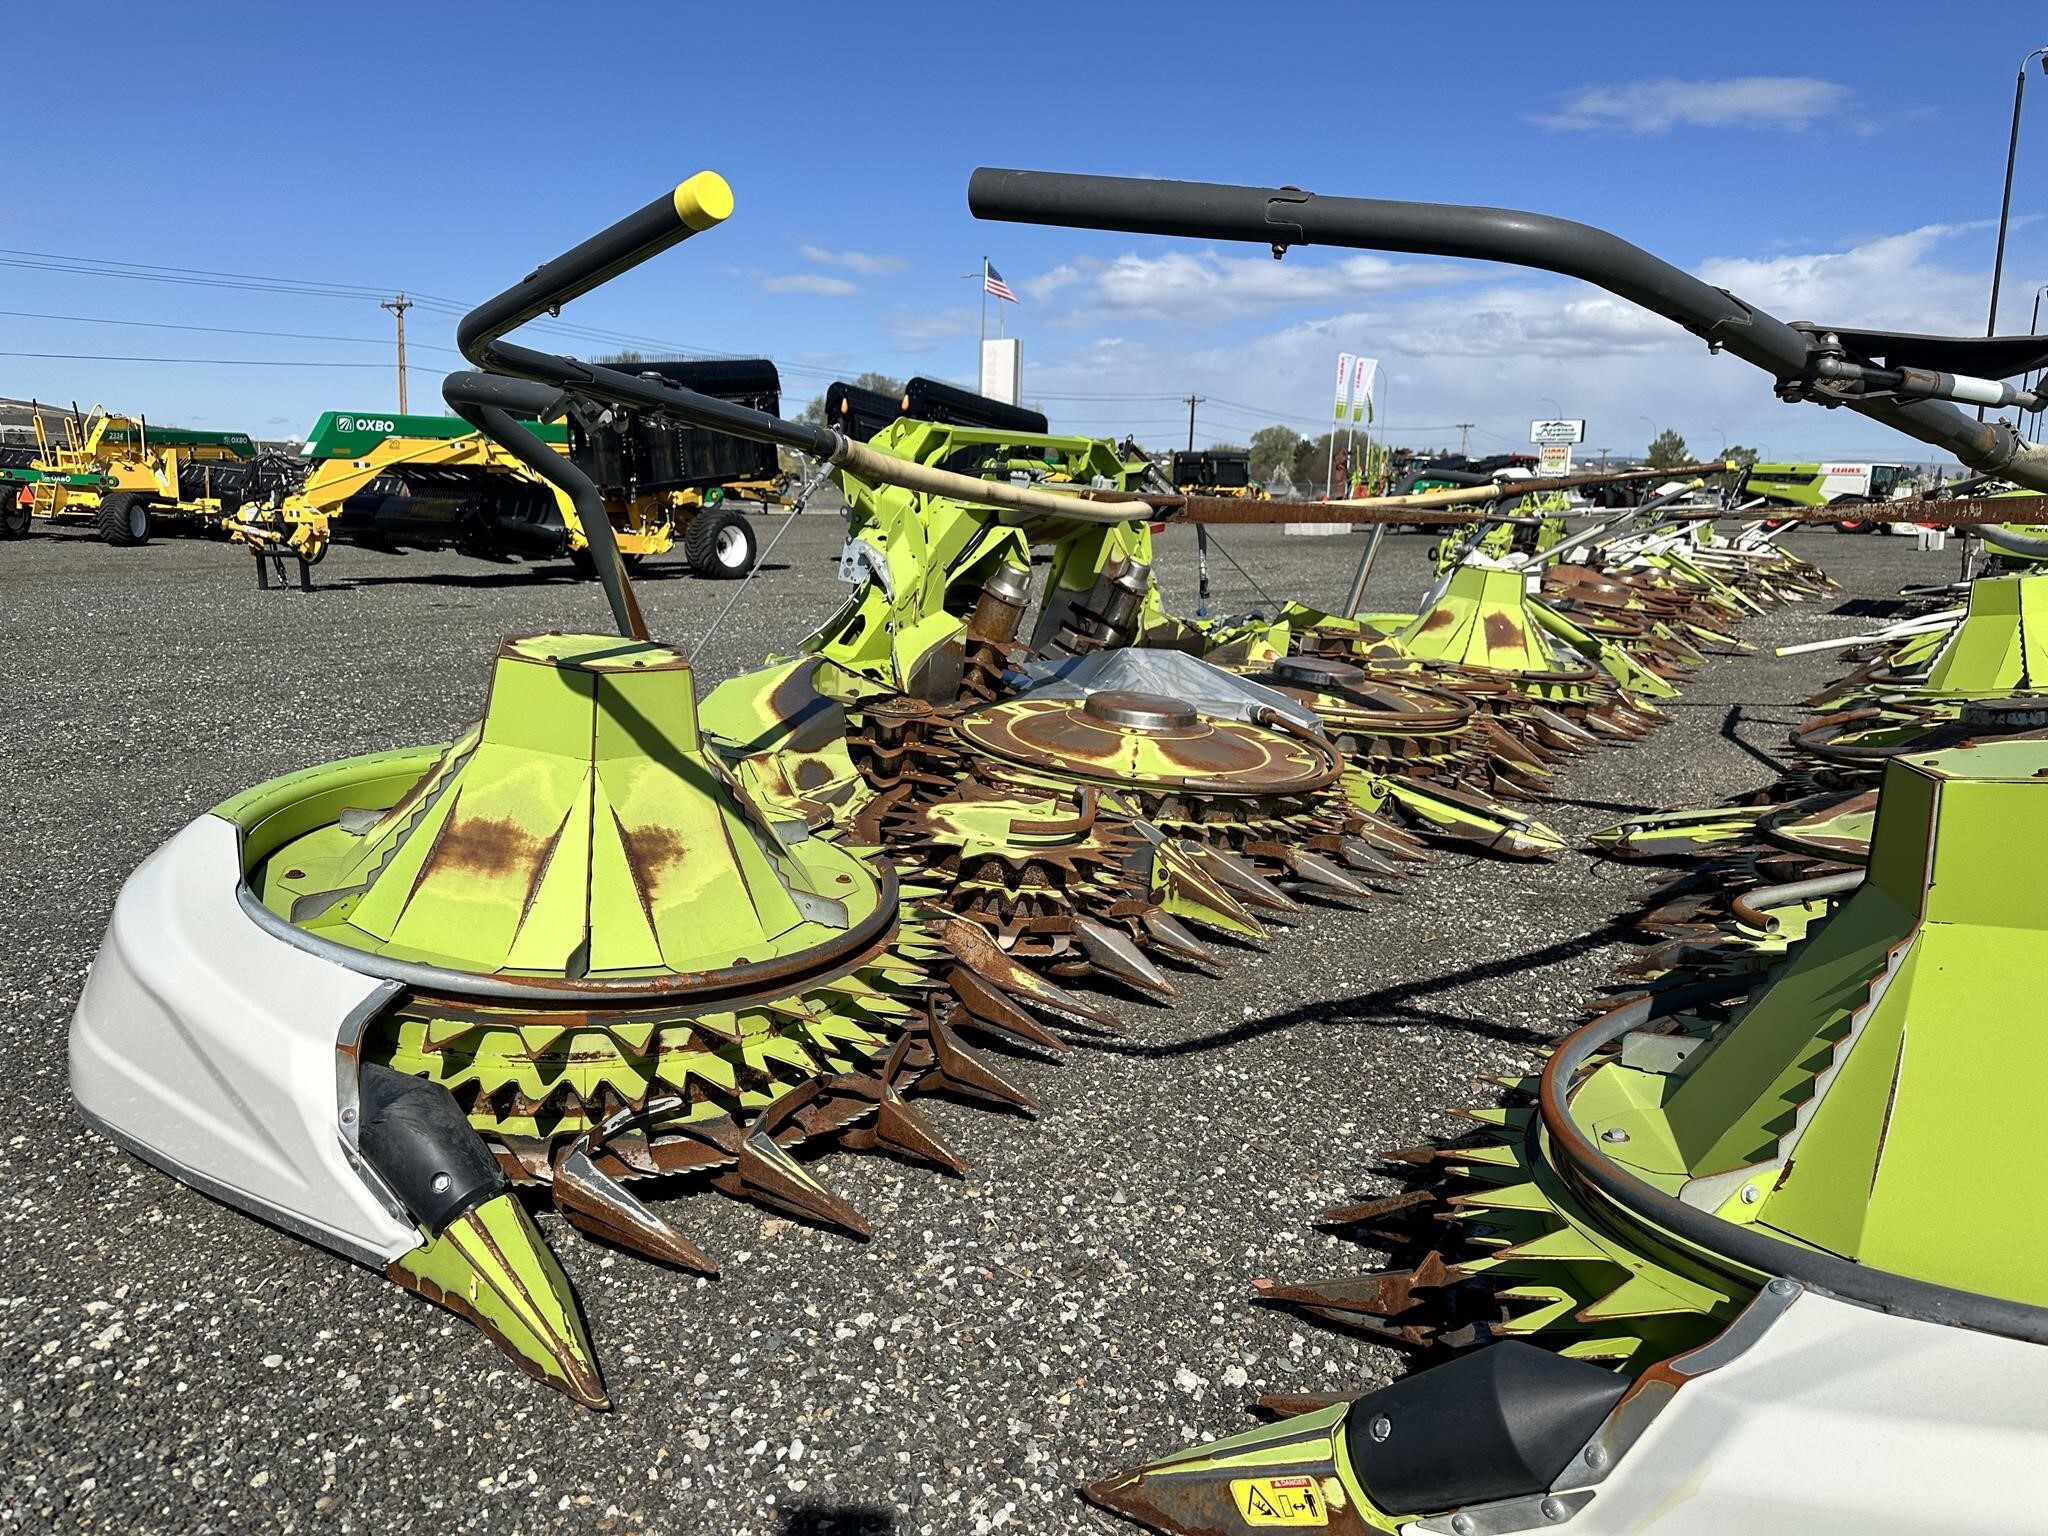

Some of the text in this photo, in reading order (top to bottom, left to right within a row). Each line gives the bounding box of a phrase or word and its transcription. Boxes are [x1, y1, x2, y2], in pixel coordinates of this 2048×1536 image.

[356, 419, 395, 432] OXBO
[109, 432, 124, 440] 2334
[231, 436, 247, 444] OXBO
